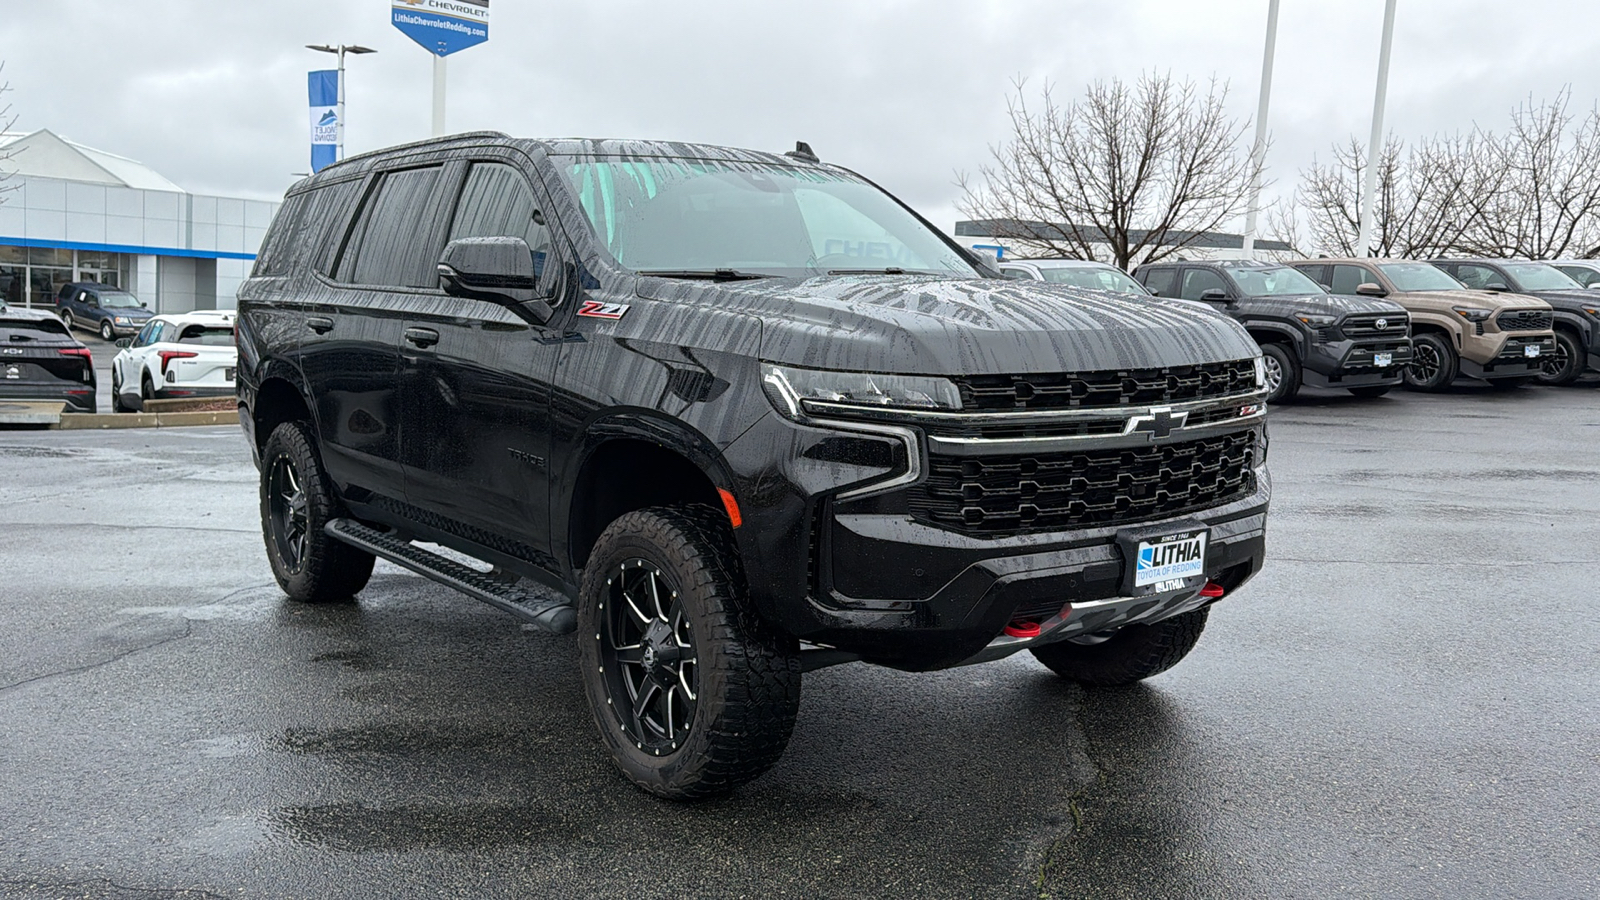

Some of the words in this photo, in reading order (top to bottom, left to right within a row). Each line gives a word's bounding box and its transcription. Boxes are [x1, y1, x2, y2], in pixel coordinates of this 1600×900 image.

[428, 0, 486, 17] CHEVROLET
[394, 13, 486, 37] LithiaChevroletRedding.com
[507, 447, 545, 467] TAHOE
[1152, 540, 1201, 567] LITHIA
[1137, 568, 1161, 580] TOYOTA
[1162, 567, 1170, 575] OF
[1171, 561, 1201, 574] REDDING
[1162, 578, 1185, 592] LITHIA
